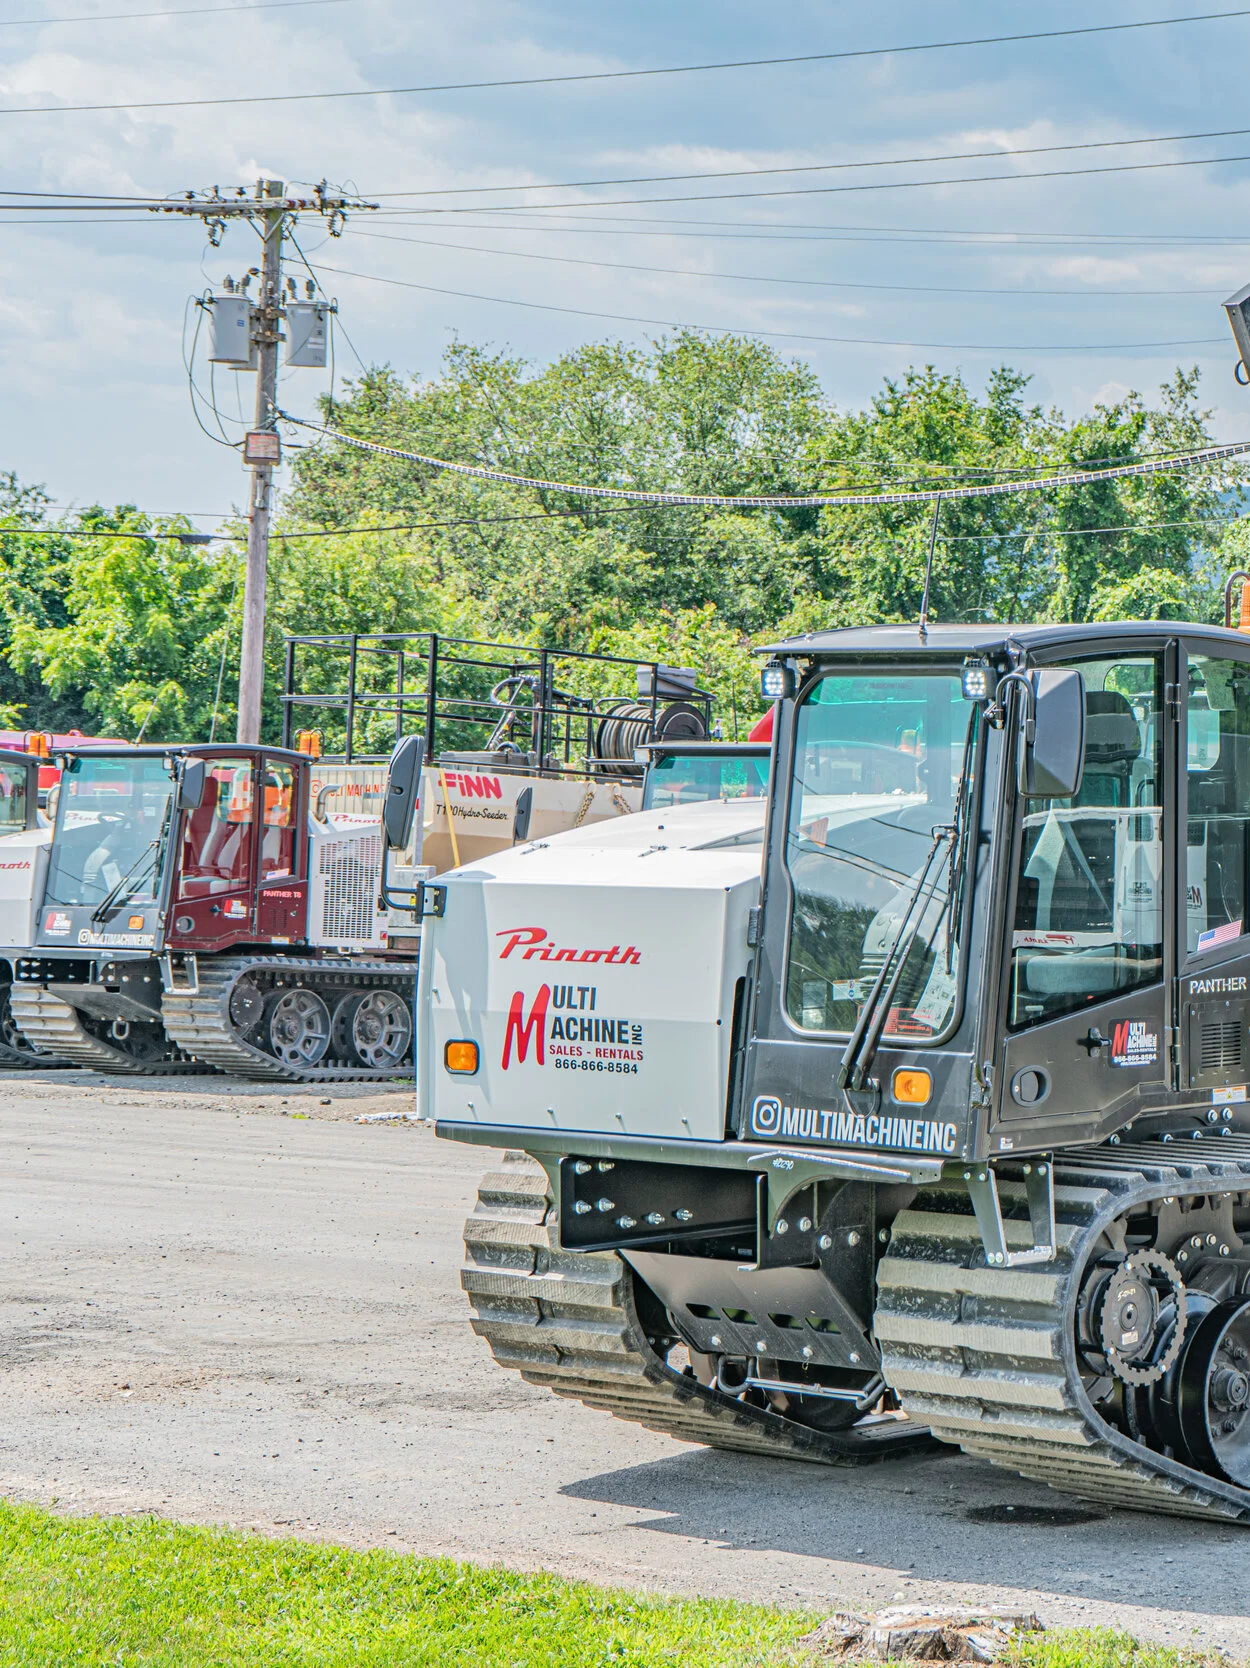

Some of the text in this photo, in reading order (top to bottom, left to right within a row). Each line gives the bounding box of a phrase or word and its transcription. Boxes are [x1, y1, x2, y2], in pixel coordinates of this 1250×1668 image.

[263, 890, 292, 898] PANTHER
[496, 927, 641, 964] Prinoth
[1189, 976, 1247, 994] PANTHER
[632, 1024, 643, 1046] INC
[549, 1044, 583, 1057] SALES
[595, 1047, 644, 1061] RENTALS
[555, 1058, 638, 1075] 866-866-8584
[782, 1106, 957, 1153] MULTIMACHINEINC
